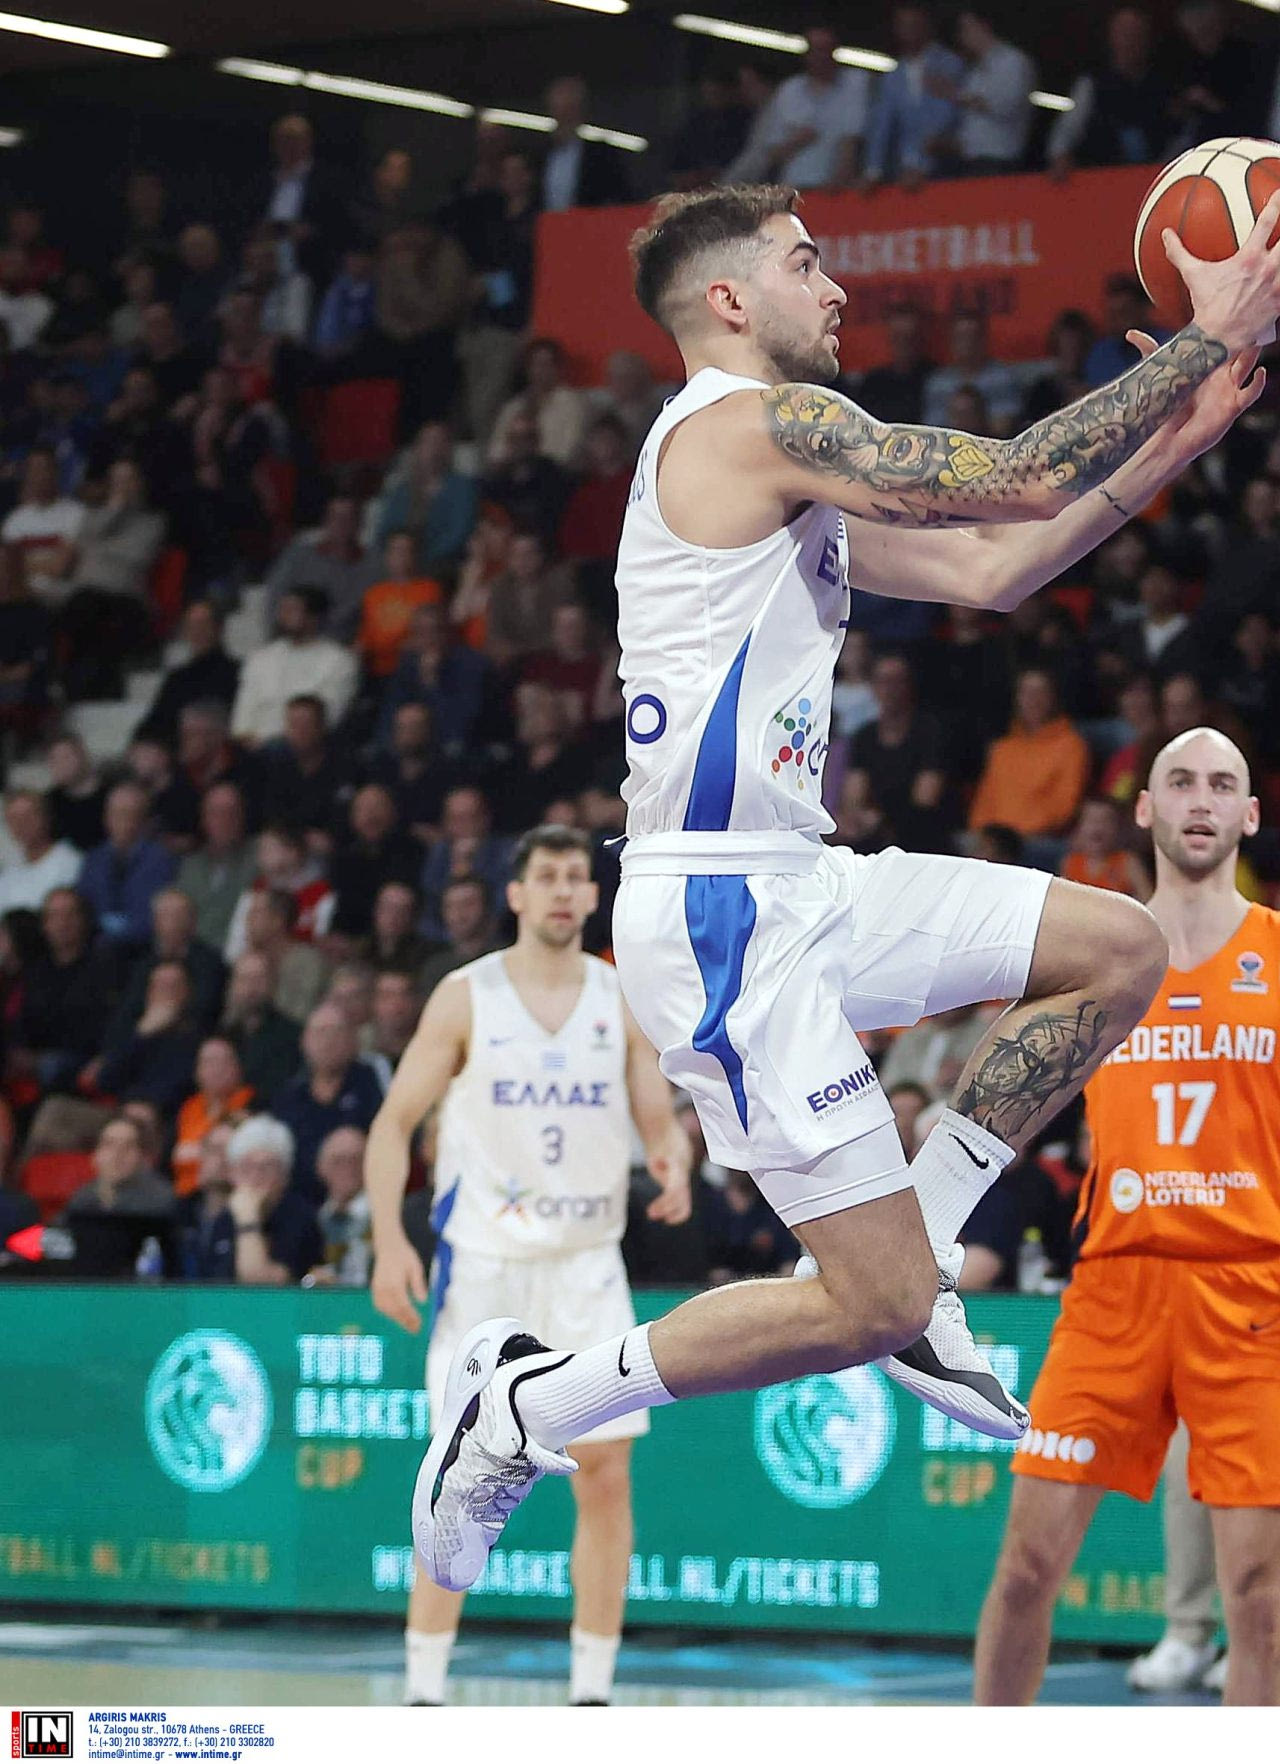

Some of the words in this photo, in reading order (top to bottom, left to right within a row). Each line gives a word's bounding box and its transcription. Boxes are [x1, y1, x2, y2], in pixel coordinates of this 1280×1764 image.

[1101, 1023, 1276, 1066] EDERLAND
[1152, 1081, 1217, 1145] 17
[541, 1125, 564, 1166] 3
[923, 1460, 995, 1507] CUP
